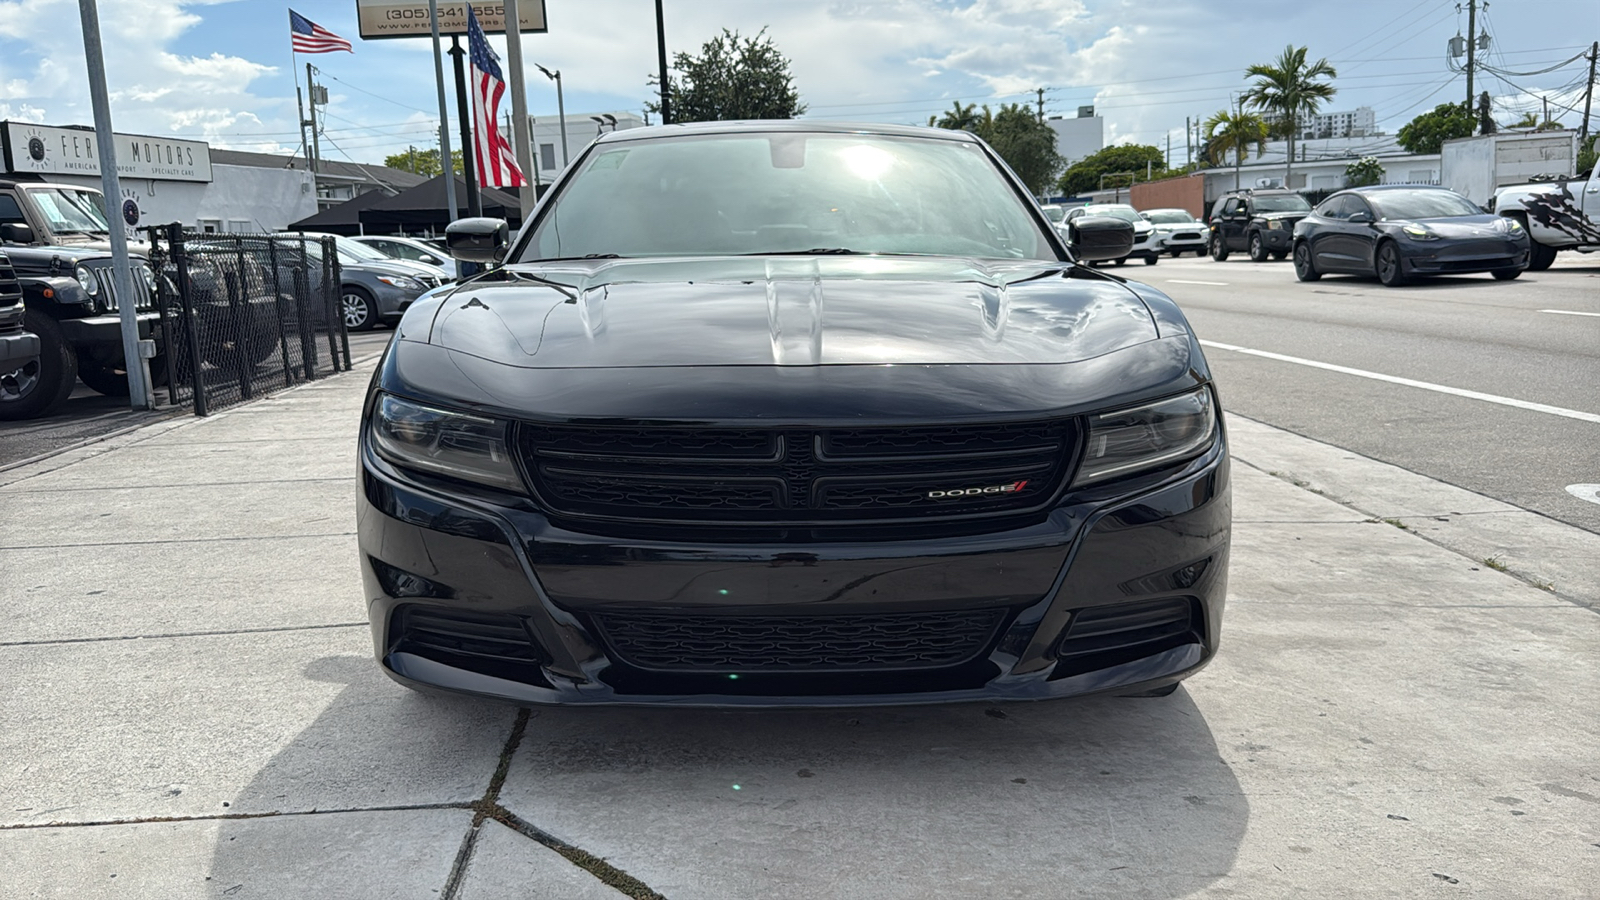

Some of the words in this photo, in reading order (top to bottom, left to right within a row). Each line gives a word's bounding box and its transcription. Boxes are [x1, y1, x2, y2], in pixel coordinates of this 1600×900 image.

[386, 8, 430, 20] (305)
[60, 135, 93, 159] FER
[131, 141, 194, 166] MOTORS
[64, 162, 98, 170] AMERICAN
[116, 165, 136, 173] MPORT
[151, 167, 179, 175] SPECIALTY
[928, 484, 1016, 498] DODGE
